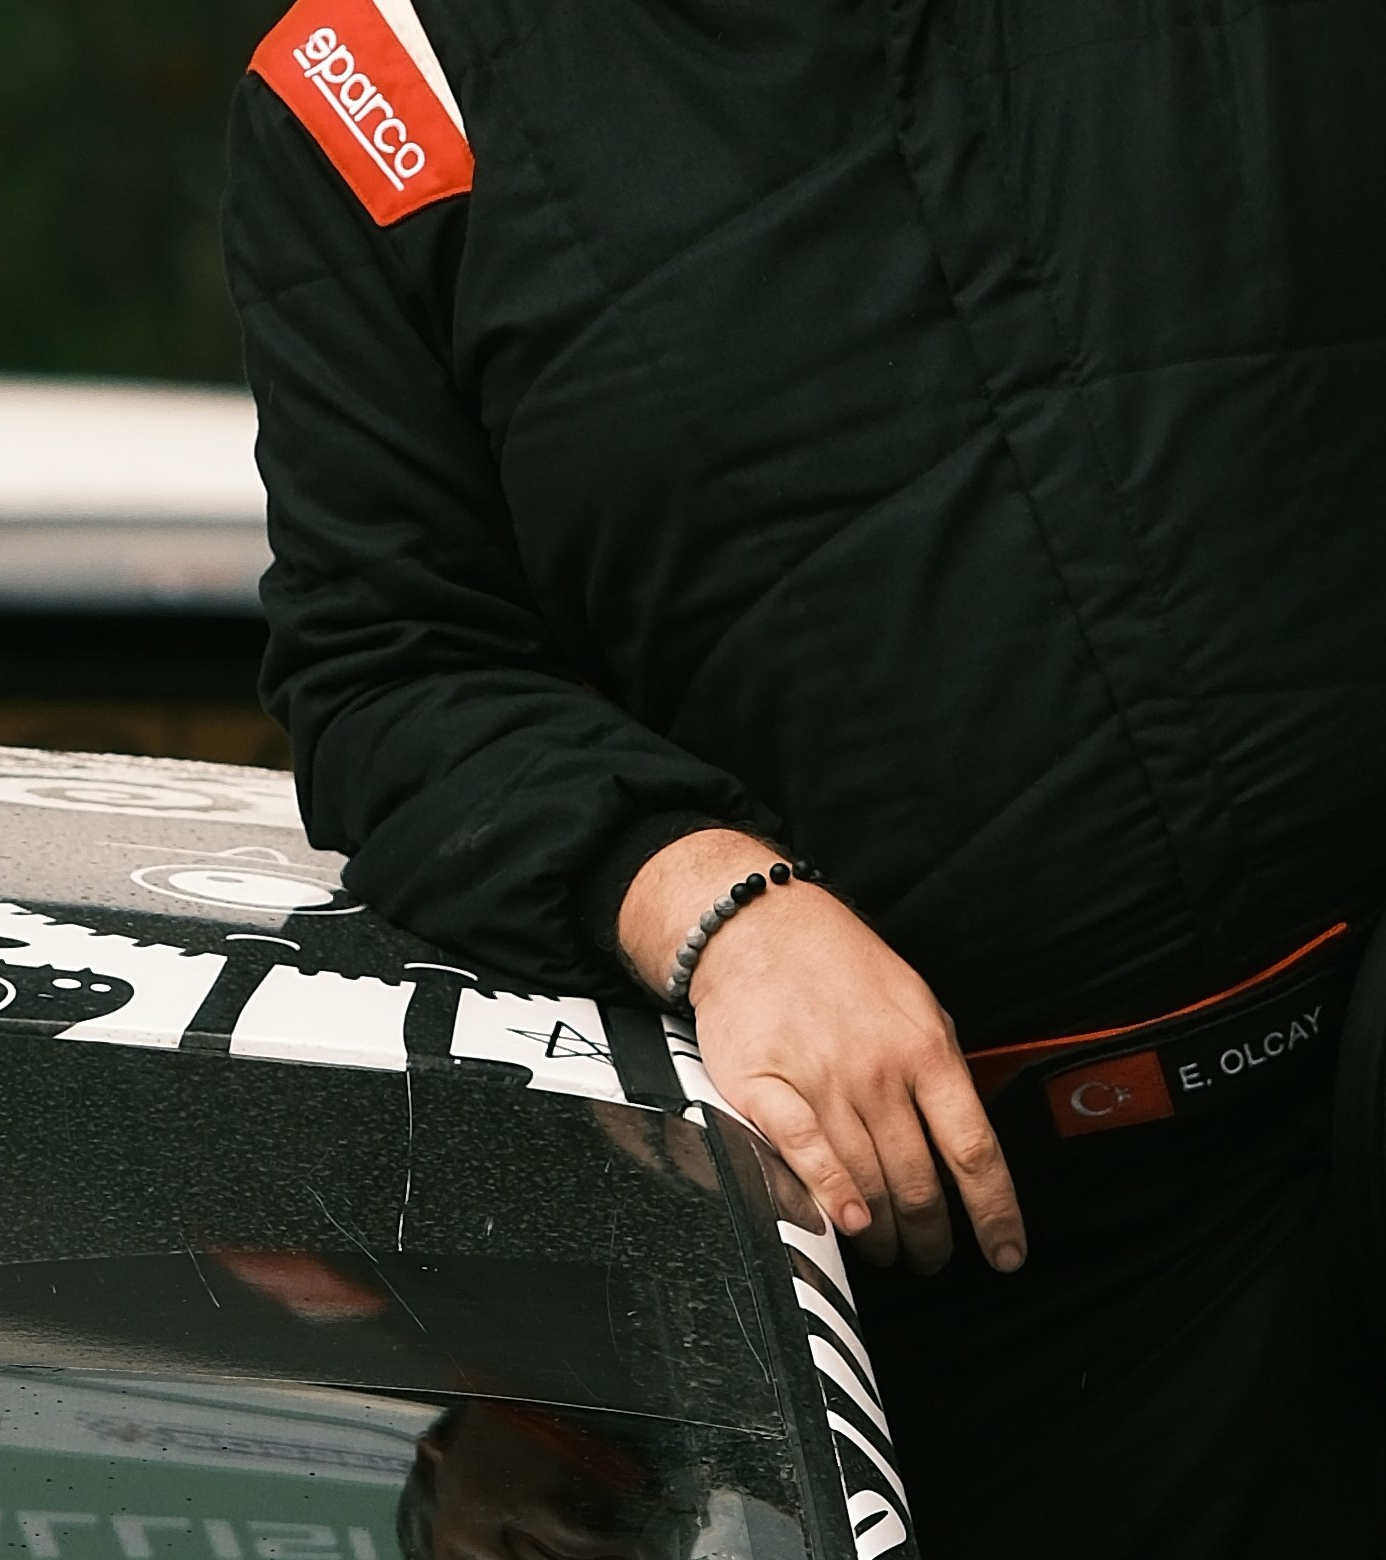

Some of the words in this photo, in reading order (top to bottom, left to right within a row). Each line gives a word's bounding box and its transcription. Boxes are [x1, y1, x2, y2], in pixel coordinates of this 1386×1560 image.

[303, 27, 425, 180] sparco
[1178, 1062, 1211, 1092] E.
[1219, 1006, 1323, 1075] OLCAY
